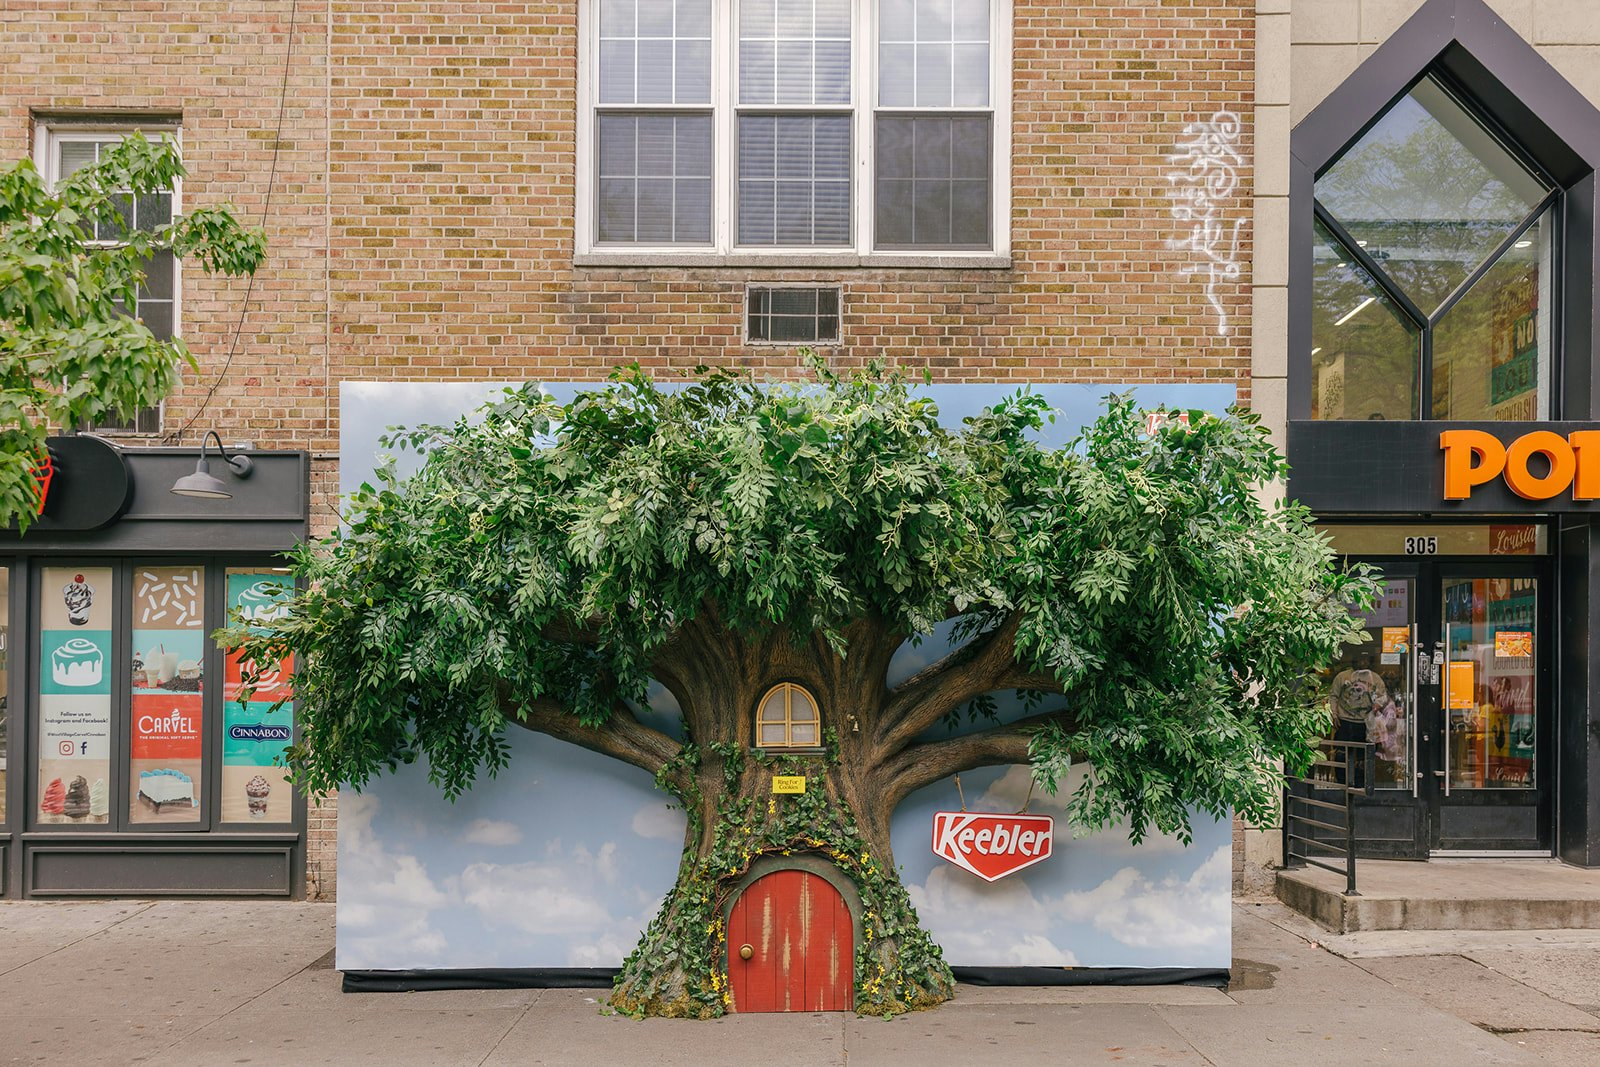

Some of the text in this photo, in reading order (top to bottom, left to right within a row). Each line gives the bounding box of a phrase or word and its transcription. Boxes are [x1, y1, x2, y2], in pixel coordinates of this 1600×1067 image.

[1406, 537, 1436, 554] 305
[138, 713, 198, 734] CARVEL
[232, 727, 287, 738] CINNABON
[938, 815, 1052, 860] Keebler
